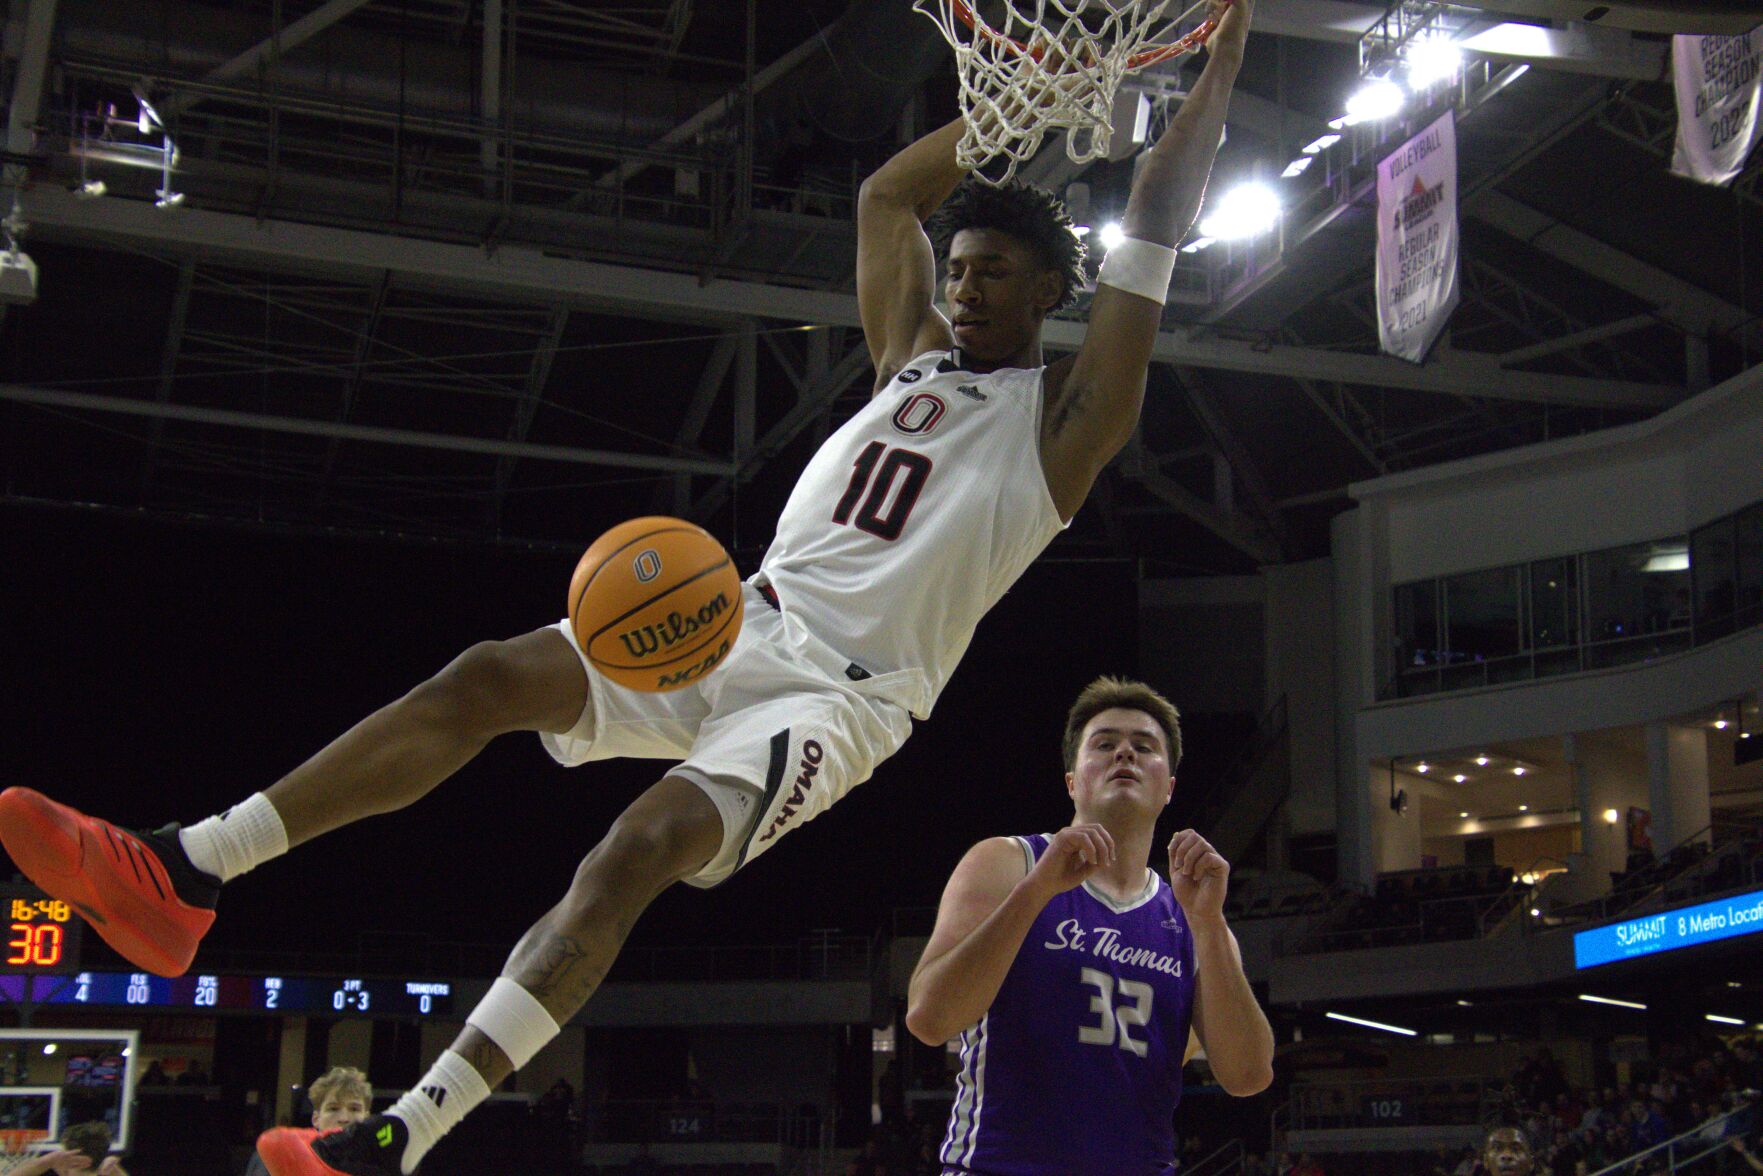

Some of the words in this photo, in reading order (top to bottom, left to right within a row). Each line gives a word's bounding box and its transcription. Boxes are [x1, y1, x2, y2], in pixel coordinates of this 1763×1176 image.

[1704, 34, 1751, 83] SEASON
[1389, 128, 1441, 179] VOLLEYBALL
[1398, 222, 1439, 262] REGULAR
[1400, 247, 1435, 281] SEASON
[1401, 301, 1426, 335] 2021
[831, 440, 933, 541] 10
[618, 592, 729, 657] Wilson
[11, 899, 70, 921] 16:48
[1678, 917, 1687, 936] 8
[1690, 912, 1727, 934] Metro
[7, 923, 63, 965] 30
[1044, 918, 1087, 952] St.
[1093, 927, 1182, 977] Thomas
[75, 984, 89, 1001] 4
[127, 985, 149, 1004] 00
[194, 987, 217, 1005] 20
[266, 989, 279, 1008] 2
[406, 982, 449, 996] TURNOVERS
[420, 995, 431, 1013] 0
[1078, 966, 1154, 1058] 32
[1371, 1100, 1402, 1118] 102
[671, 1118, 699, 1134] 124
